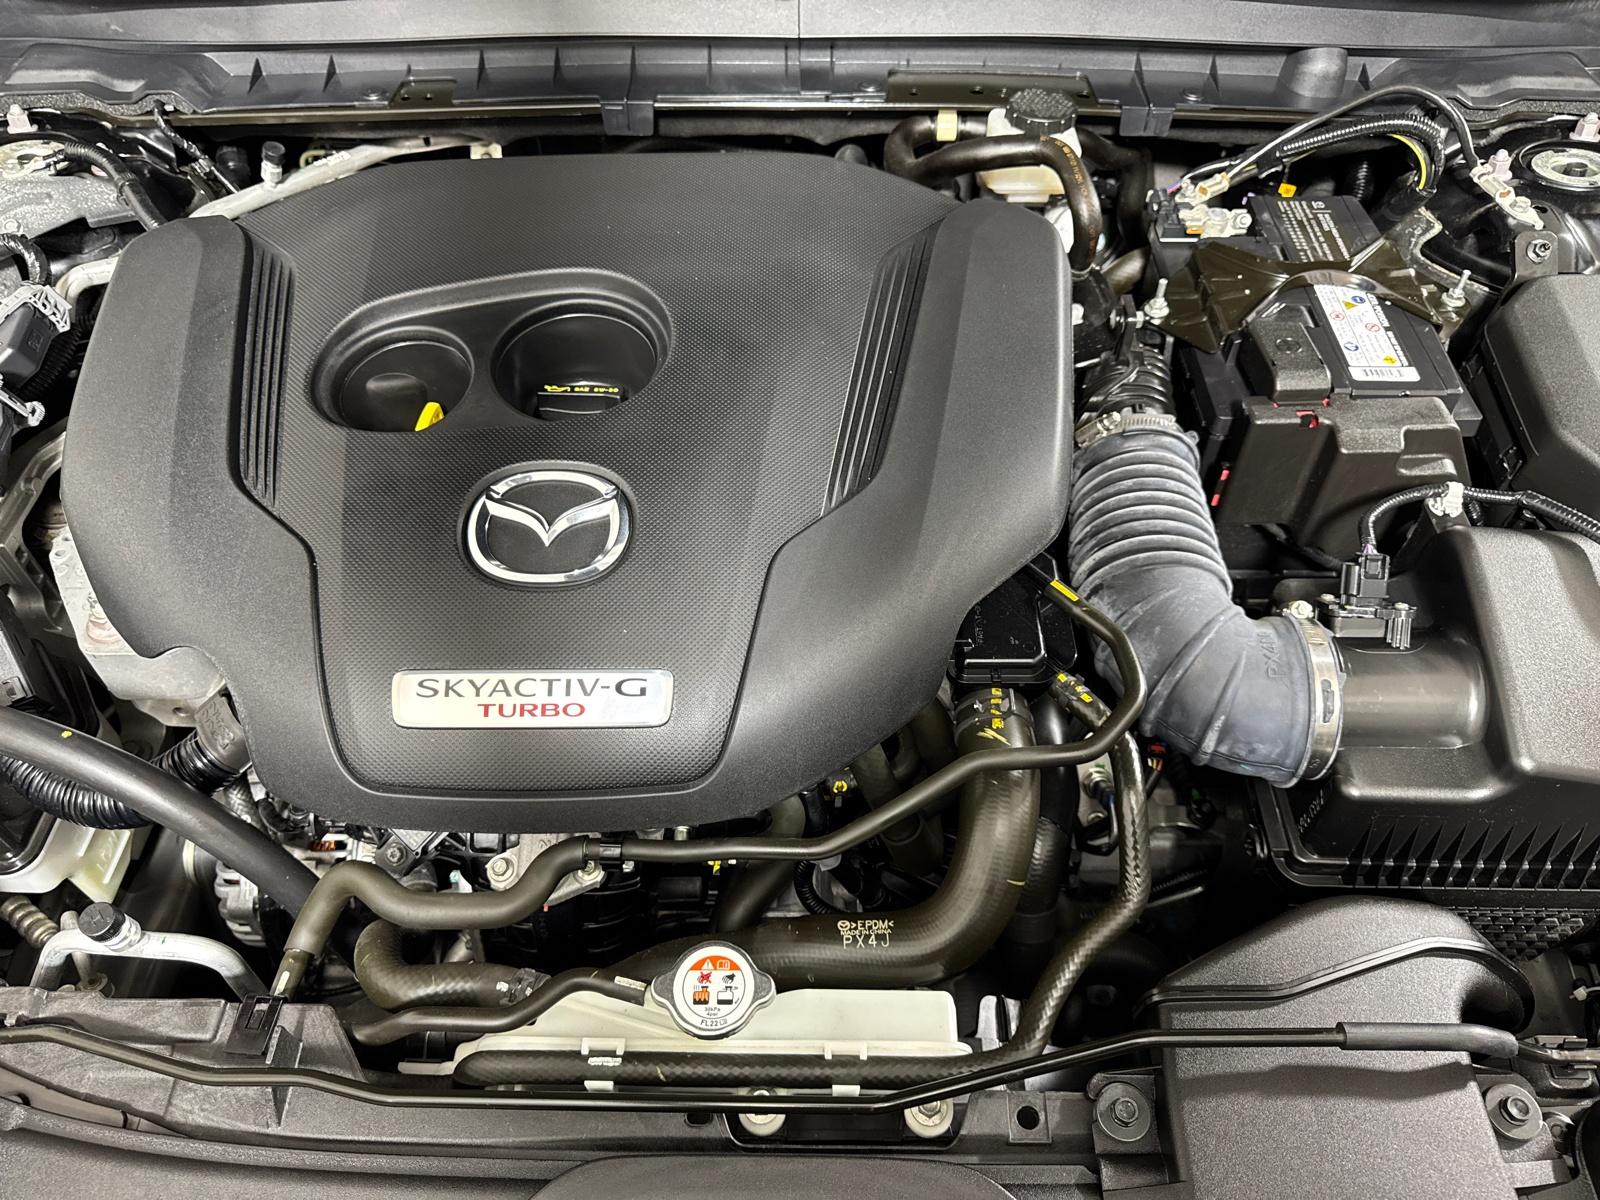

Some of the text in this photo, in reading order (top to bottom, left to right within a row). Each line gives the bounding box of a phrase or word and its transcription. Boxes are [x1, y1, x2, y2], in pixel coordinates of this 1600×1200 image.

[415, 677, 648, 698] SKYACTIV-G
[477, 702, 586, 718] TURBO
[700, 1019, 718, 1027] FL22
